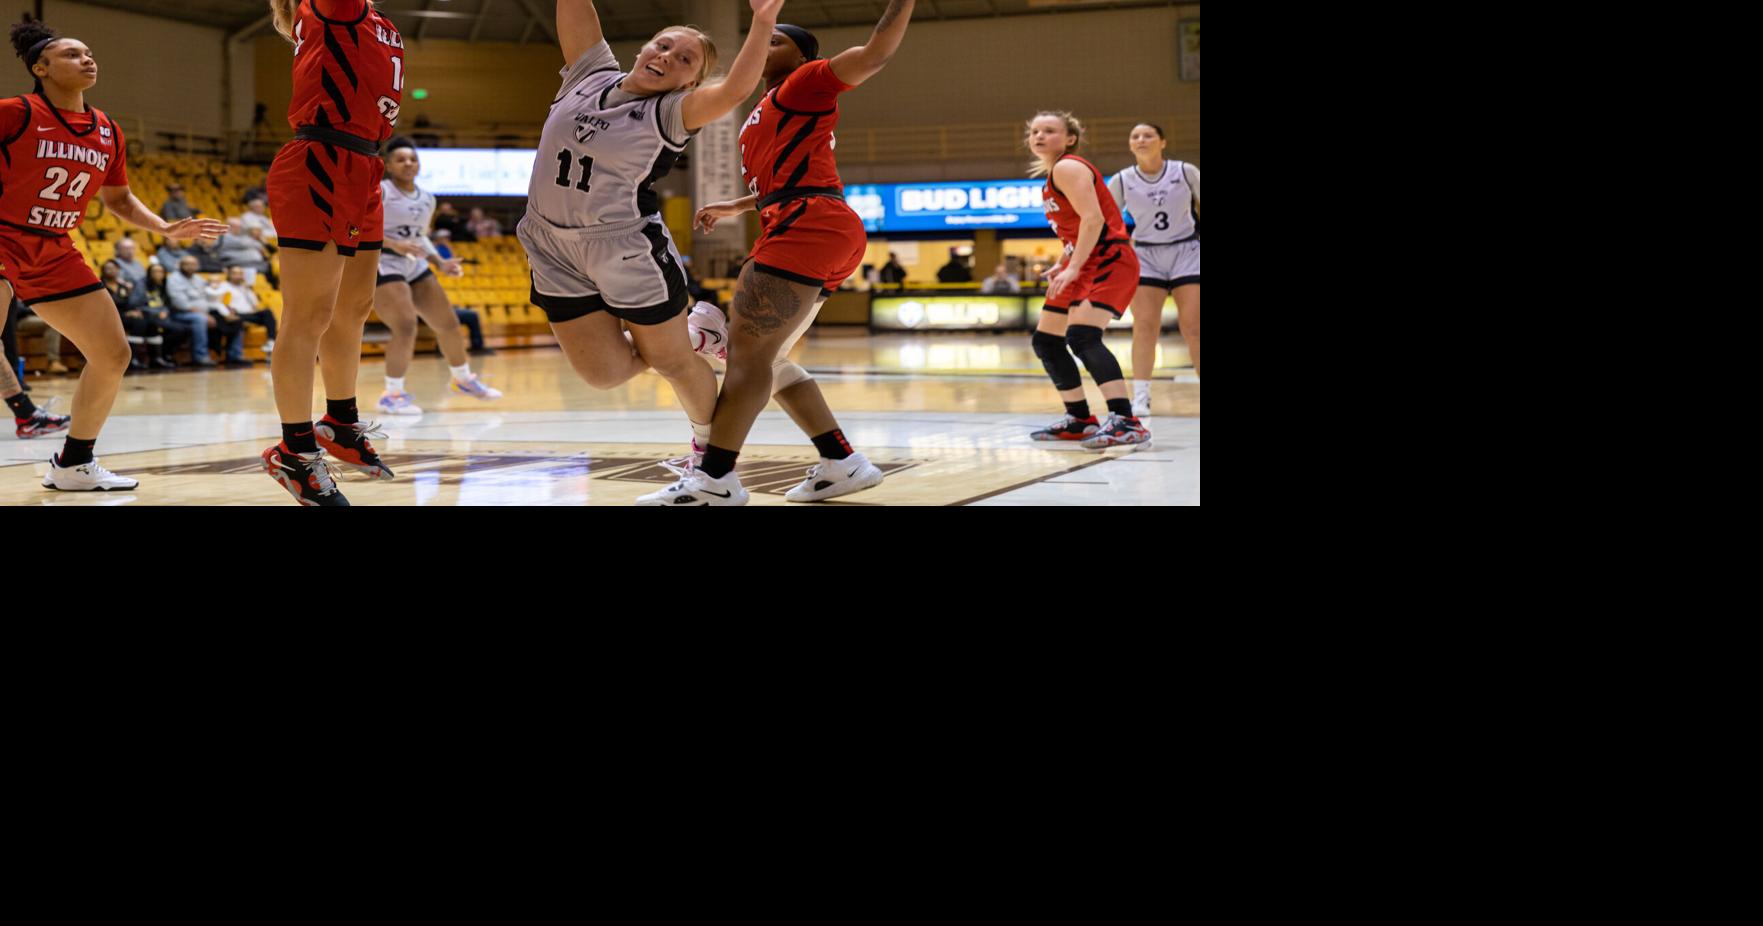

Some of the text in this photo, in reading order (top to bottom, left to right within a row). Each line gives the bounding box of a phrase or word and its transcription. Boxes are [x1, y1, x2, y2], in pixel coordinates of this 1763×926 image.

[574, 112, 610, 131] VALPO
[36, 138, 110, 172] ILLINOIS
[39, 166, 91, 202] 24
[555, 147, 594, 194] 11
[901, 188, 967, 211] BUD
[968, 184, 1044, 209] LIGH
[27, 204, 81, 229] STATE
[1154, 211, 1169, 231] 3
